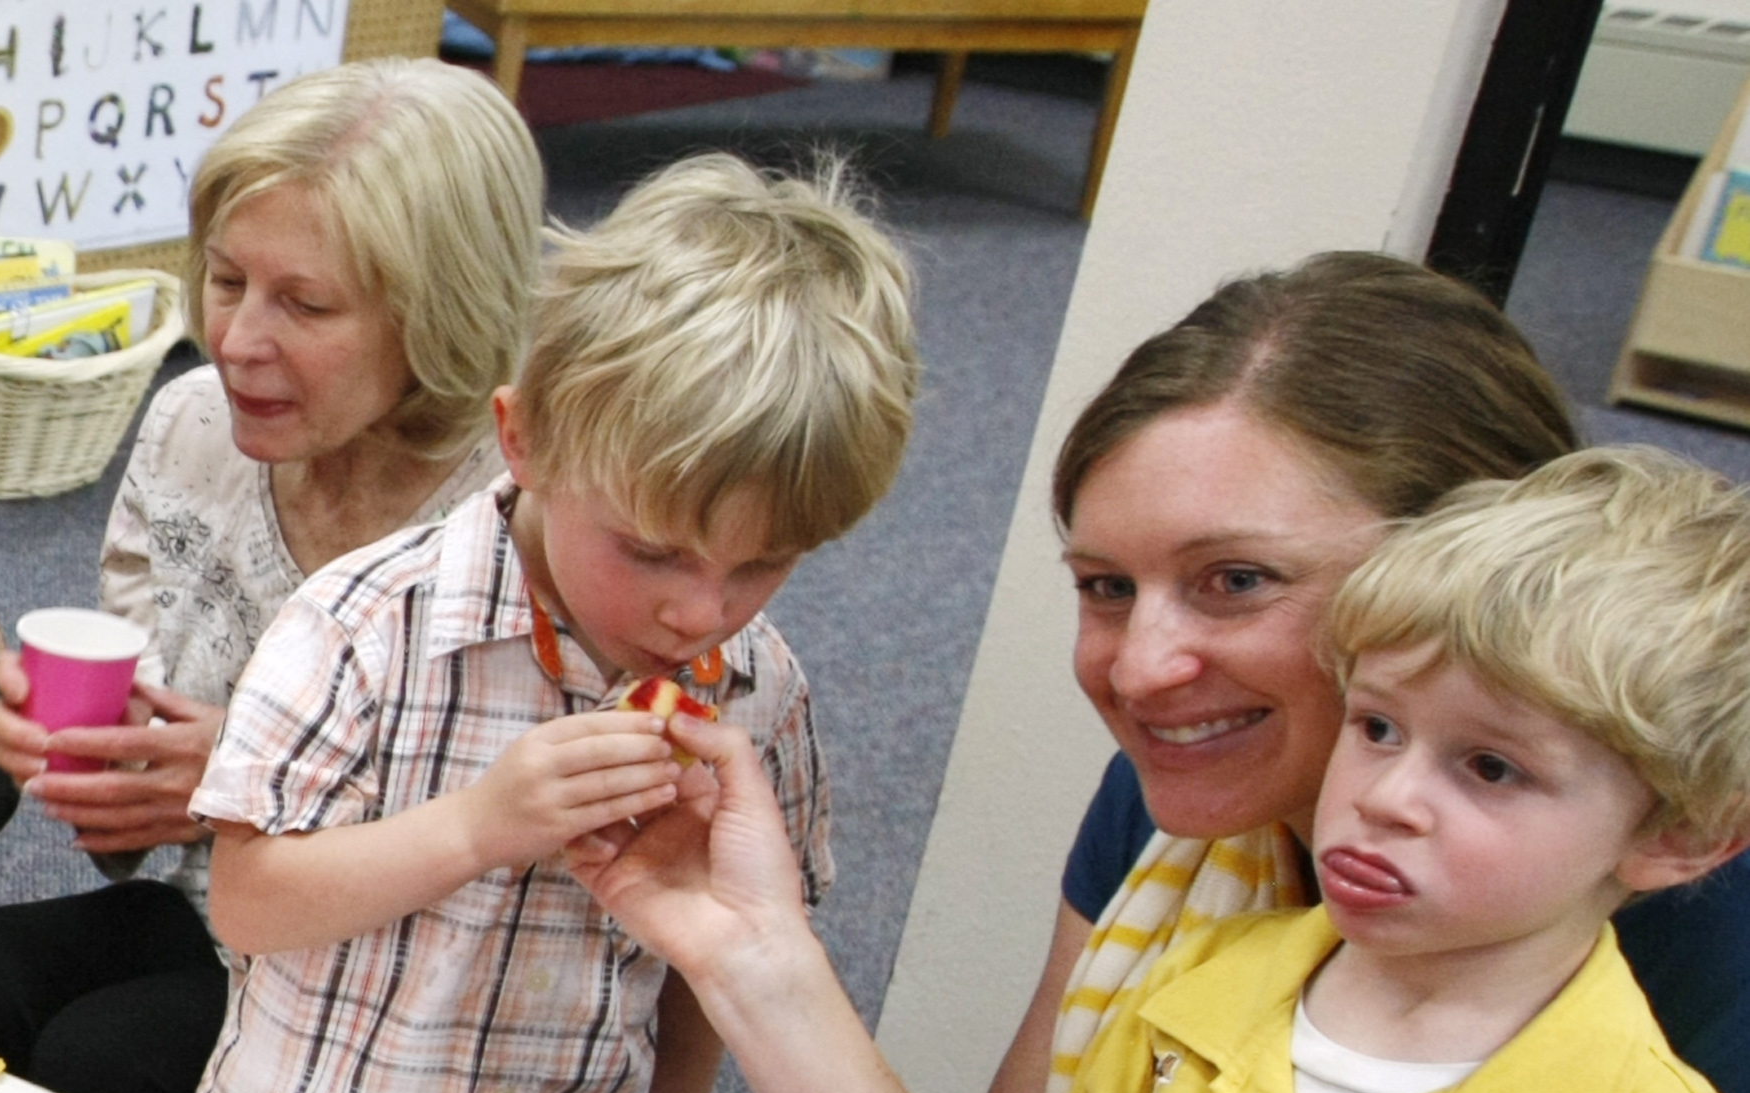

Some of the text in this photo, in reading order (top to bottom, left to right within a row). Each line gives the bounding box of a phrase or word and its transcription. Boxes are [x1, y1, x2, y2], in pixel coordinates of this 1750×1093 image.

[51, 15, 68, 77] I
[133, 8, 167, 62] K
[189, 5, 214, 54] L
[236, 0, 275, 43] M
[295, 0, 336, 39] N
[36, 99, 65, 159] P
[89, 93, 126, 148] Q
[146, 84, 175, 137] R
[198, 75, 226, 128] S
[36, 171, 92, 225] W
[113, 163, 146, 214] X
